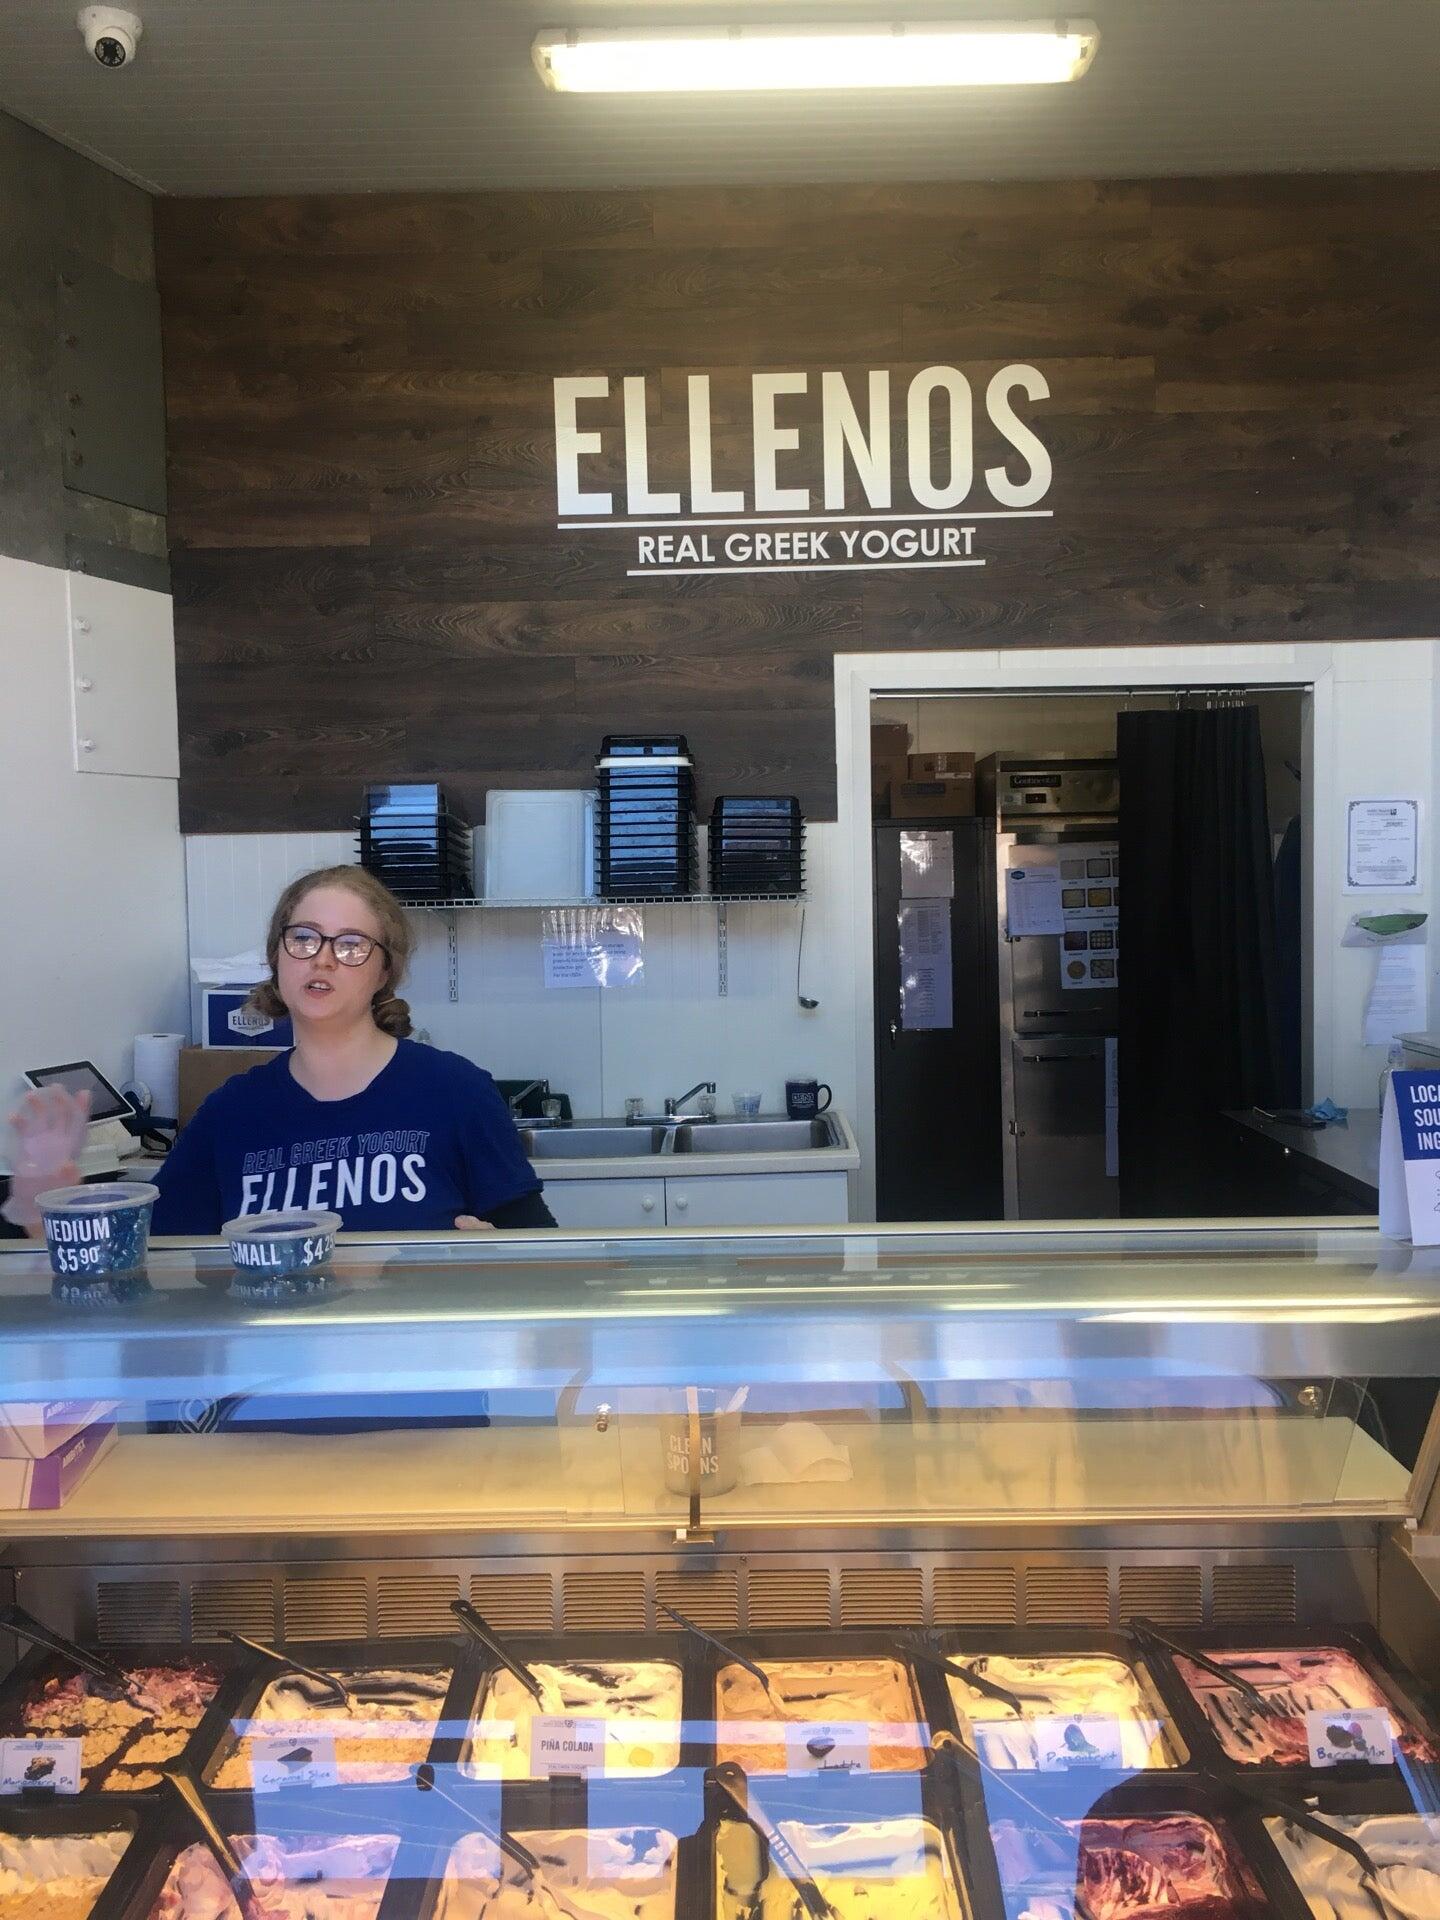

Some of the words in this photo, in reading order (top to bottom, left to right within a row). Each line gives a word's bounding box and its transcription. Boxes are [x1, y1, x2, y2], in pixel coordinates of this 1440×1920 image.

[553, 363, 1053, 516] ELLENOS
[638, 534, 716, 564] REAL
[725, 531, 830, 562] GREEK
[839, 527, 977, 560] YOGURT
[1410, 1084, 1440, 1103] LOC
[242, 1147, 286, 1174] REAL
[290, 1136, 352, 1166] GREEK
[357, 1130, 430, 1155] YOGURT
[239, 1153, 427, 1217] ELLENOS
[44, 1217, 111, 1242] MEDIUM
[231, 1240, 282, 1266] SMALL
[670, 1435, 712, 1454] CLEN
[667, 1455, 719, 1474] SPONS
[562, 1740, 594, 1752] COLADA
